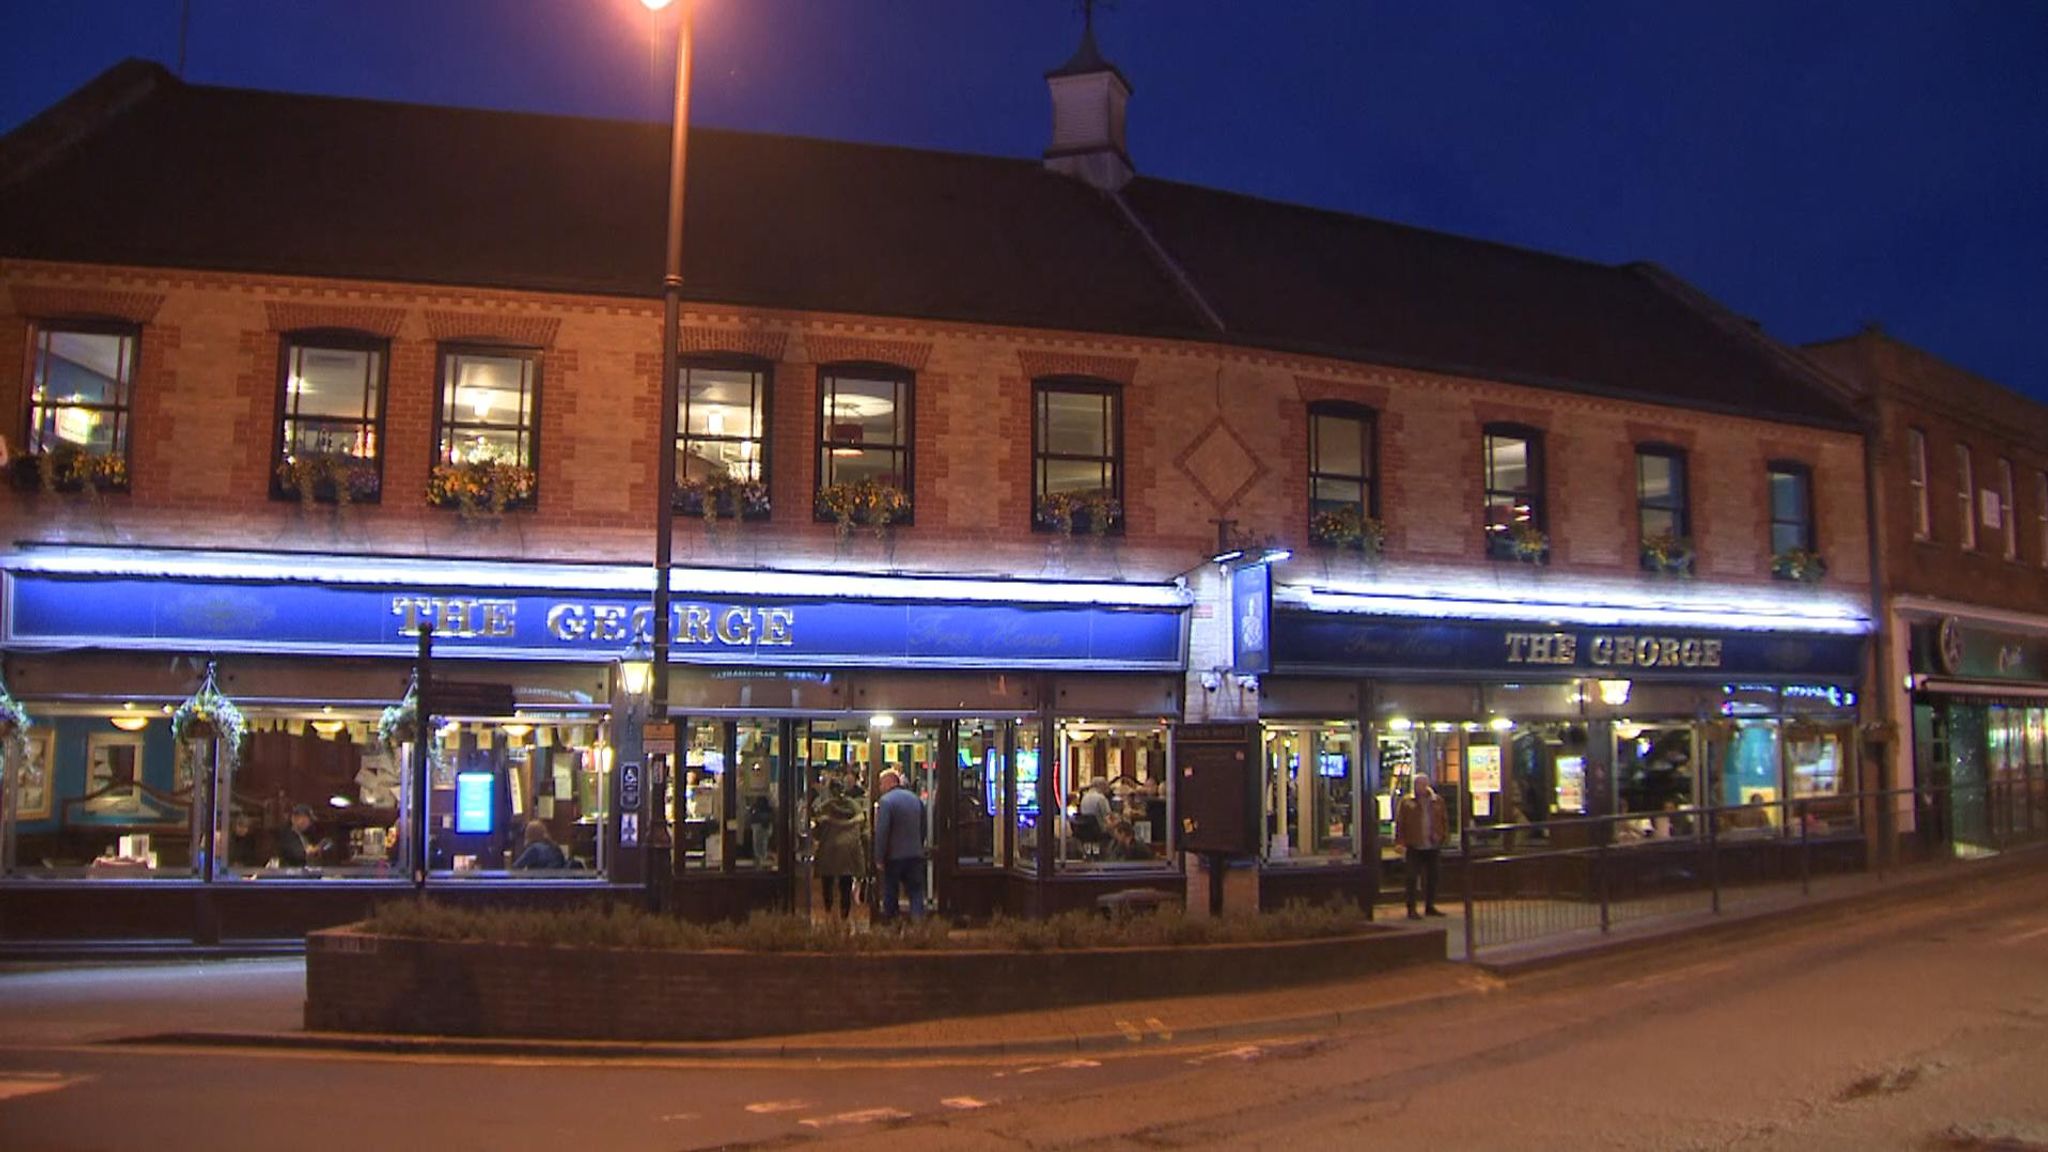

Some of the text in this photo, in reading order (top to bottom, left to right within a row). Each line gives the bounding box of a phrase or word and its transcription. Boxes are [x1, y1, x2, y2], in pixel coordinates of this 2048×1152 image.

[392, 596, 795, 646] THE GEORGE
[1504, 632, 1577, 665] THE
[1590, 635, 1722, 667] GEORGE
